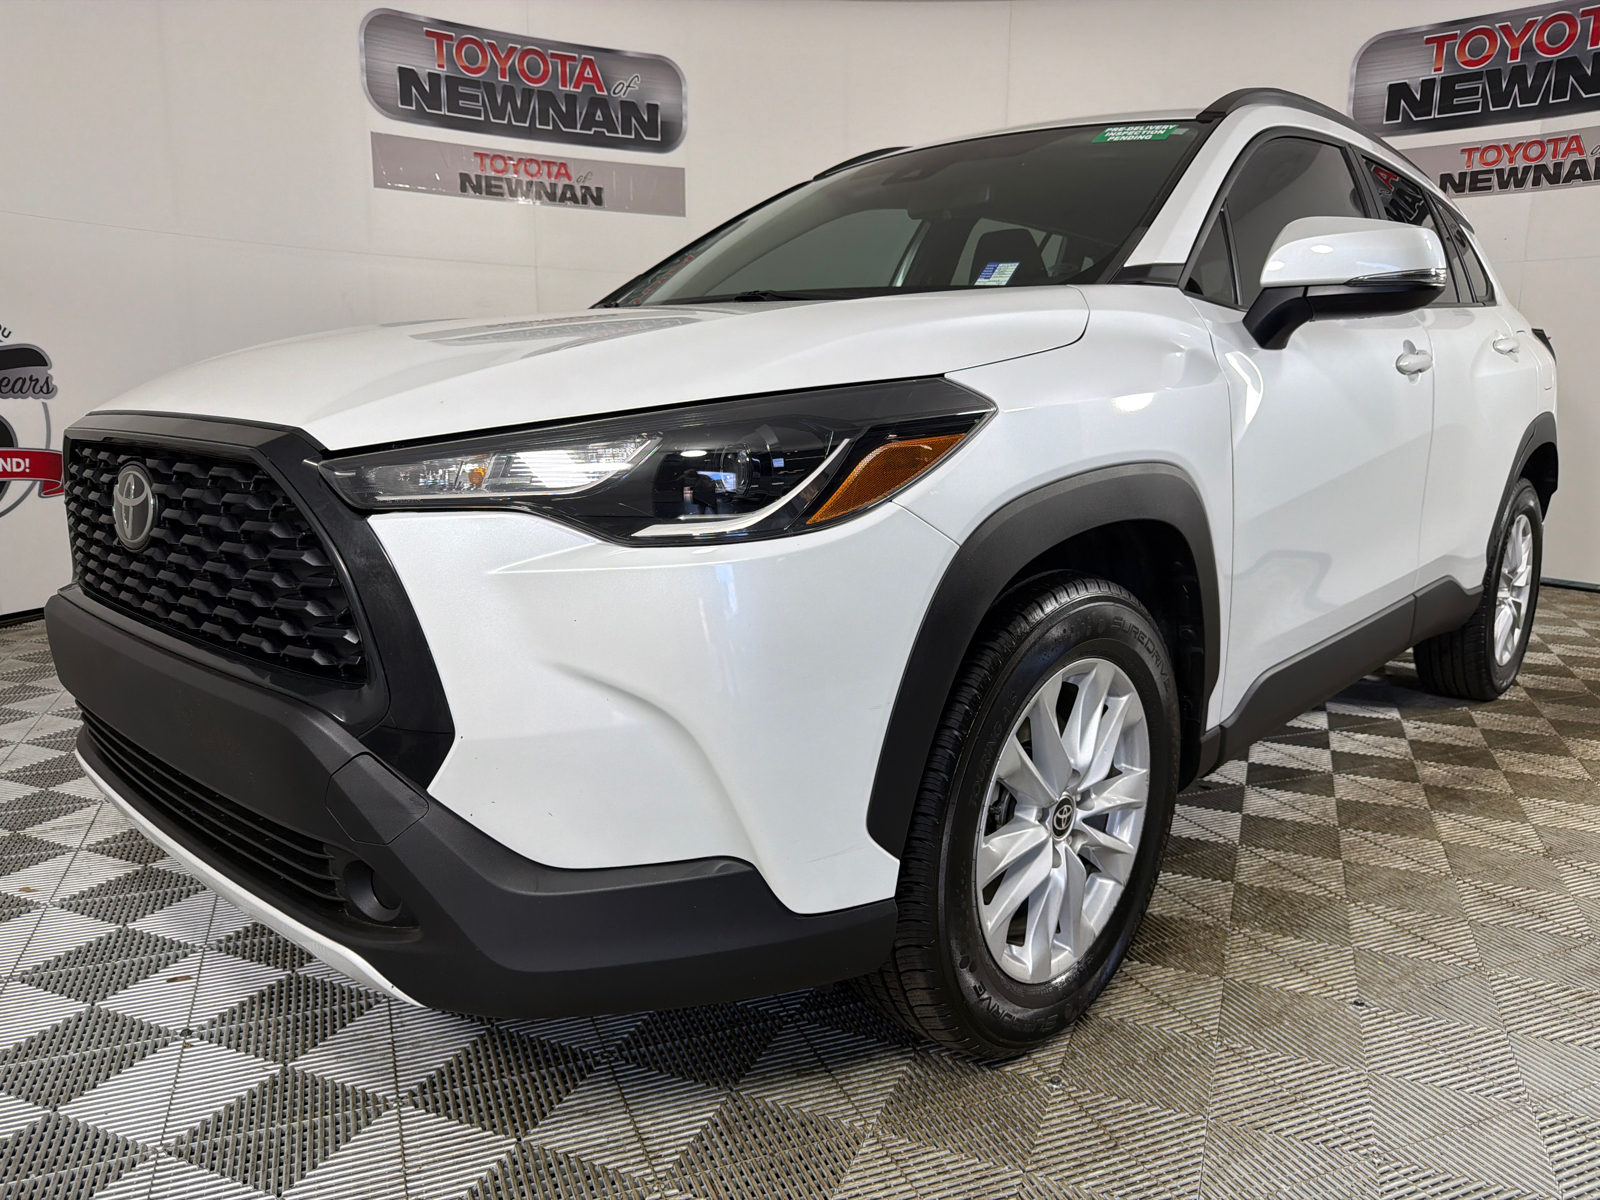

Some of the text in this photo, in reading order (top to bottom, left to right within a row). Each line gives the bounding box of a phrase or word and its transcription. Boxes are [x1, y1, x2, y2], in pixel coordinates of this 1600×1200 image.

[423, 27, 641, 98] TOYOTA of
[397, 64, 662, 142] NEWNAN
[1104, 129, 1167, 137] INSPECTION
[1106, 134, 1153, 142] PENDING
[473, 151, 572, 182] TOYOTA
[1459, 134, 1586, 169] TOYOTA
[458, 172, 604, 207] NEWNAN
[1438, 155, 1600, 194] NEWNA
